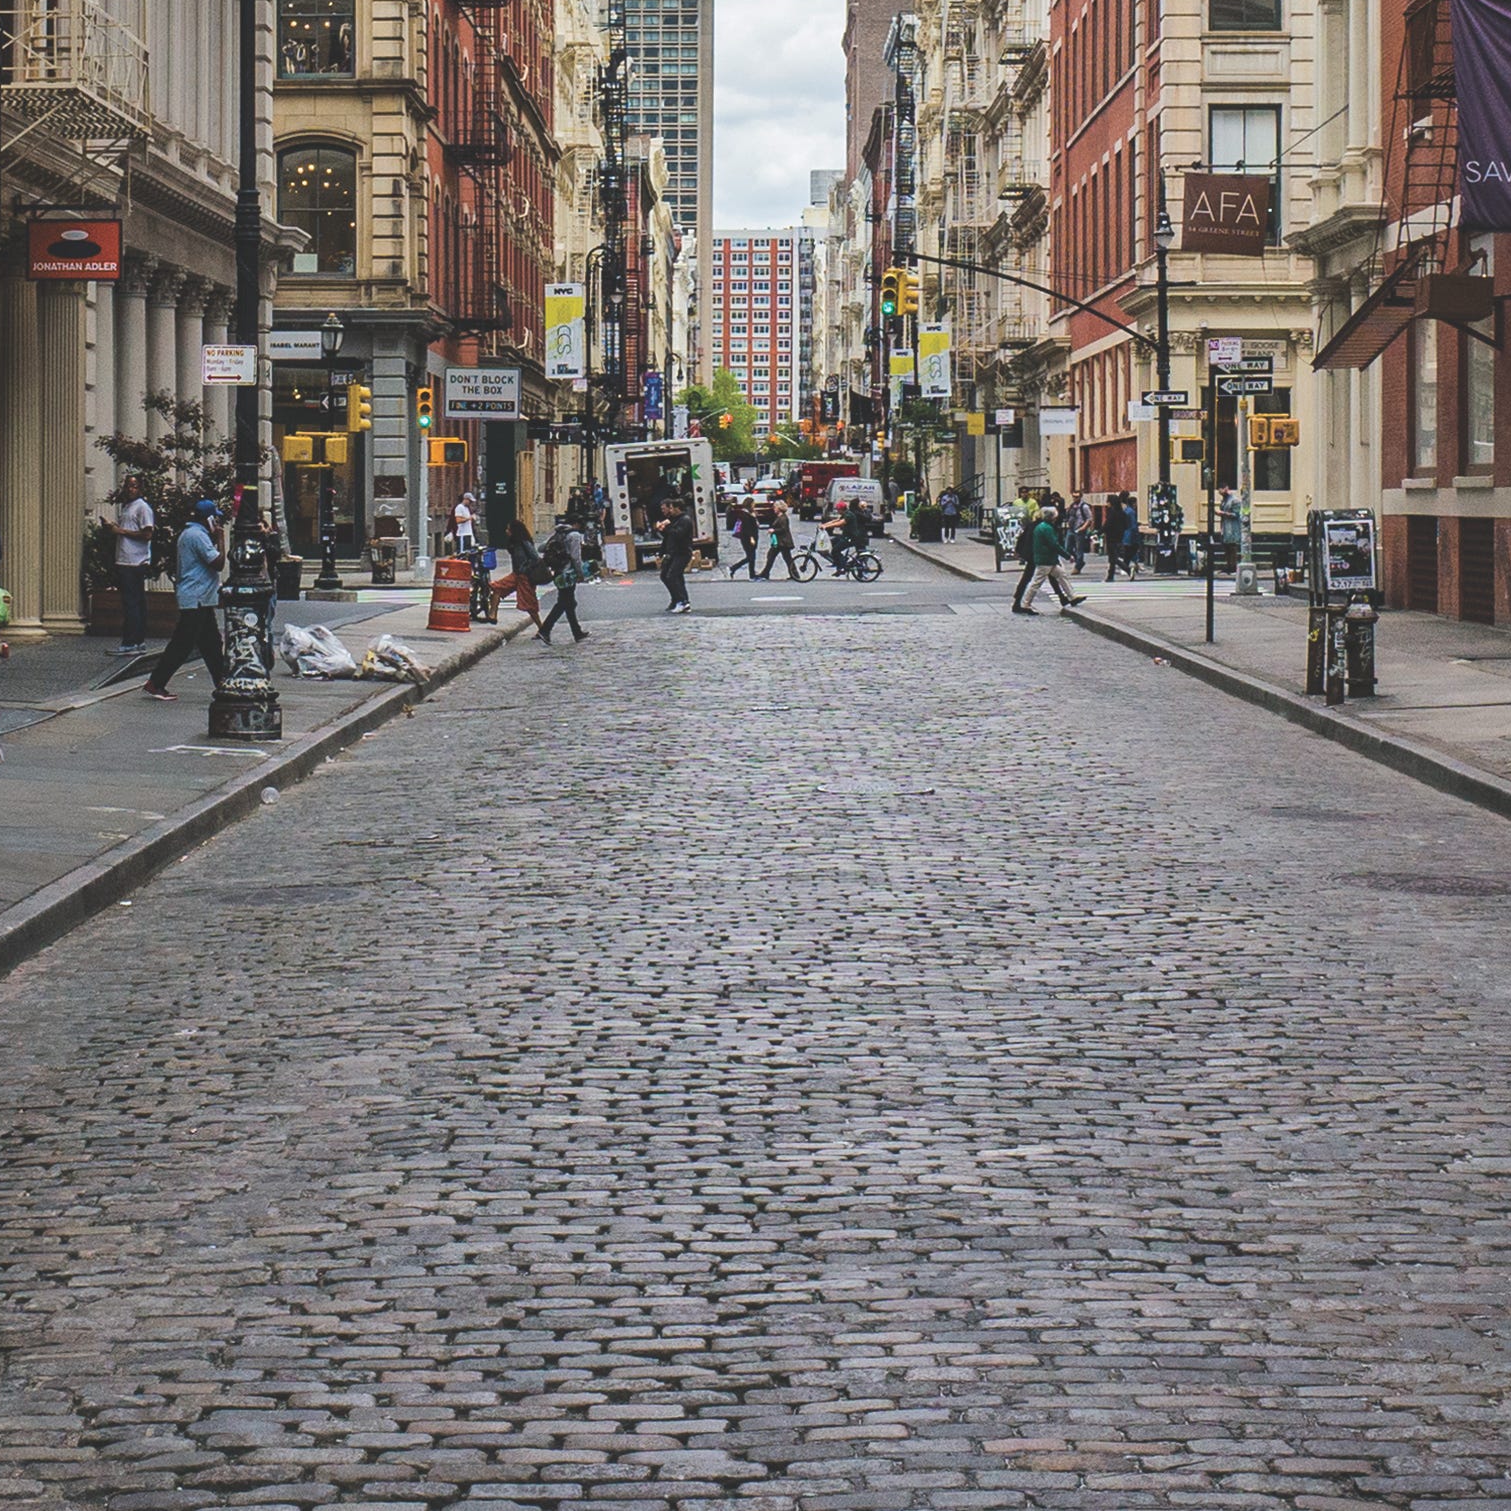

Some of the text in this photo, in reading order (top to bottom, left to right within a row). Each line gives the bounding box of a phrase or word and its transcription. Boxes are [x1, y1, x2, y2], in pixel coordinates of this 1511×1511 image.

[1190, 191, 1260, 226] AFA
[1231, 228, 1260, 237] STREET
[33, 262, 117, 272] JONATHAN ADLER
[206, 349, 244, 357] NO PARKING
[450, 375, 514, 385] DON'T BLOCK
[462, 386, 503, 395] THE BOX
